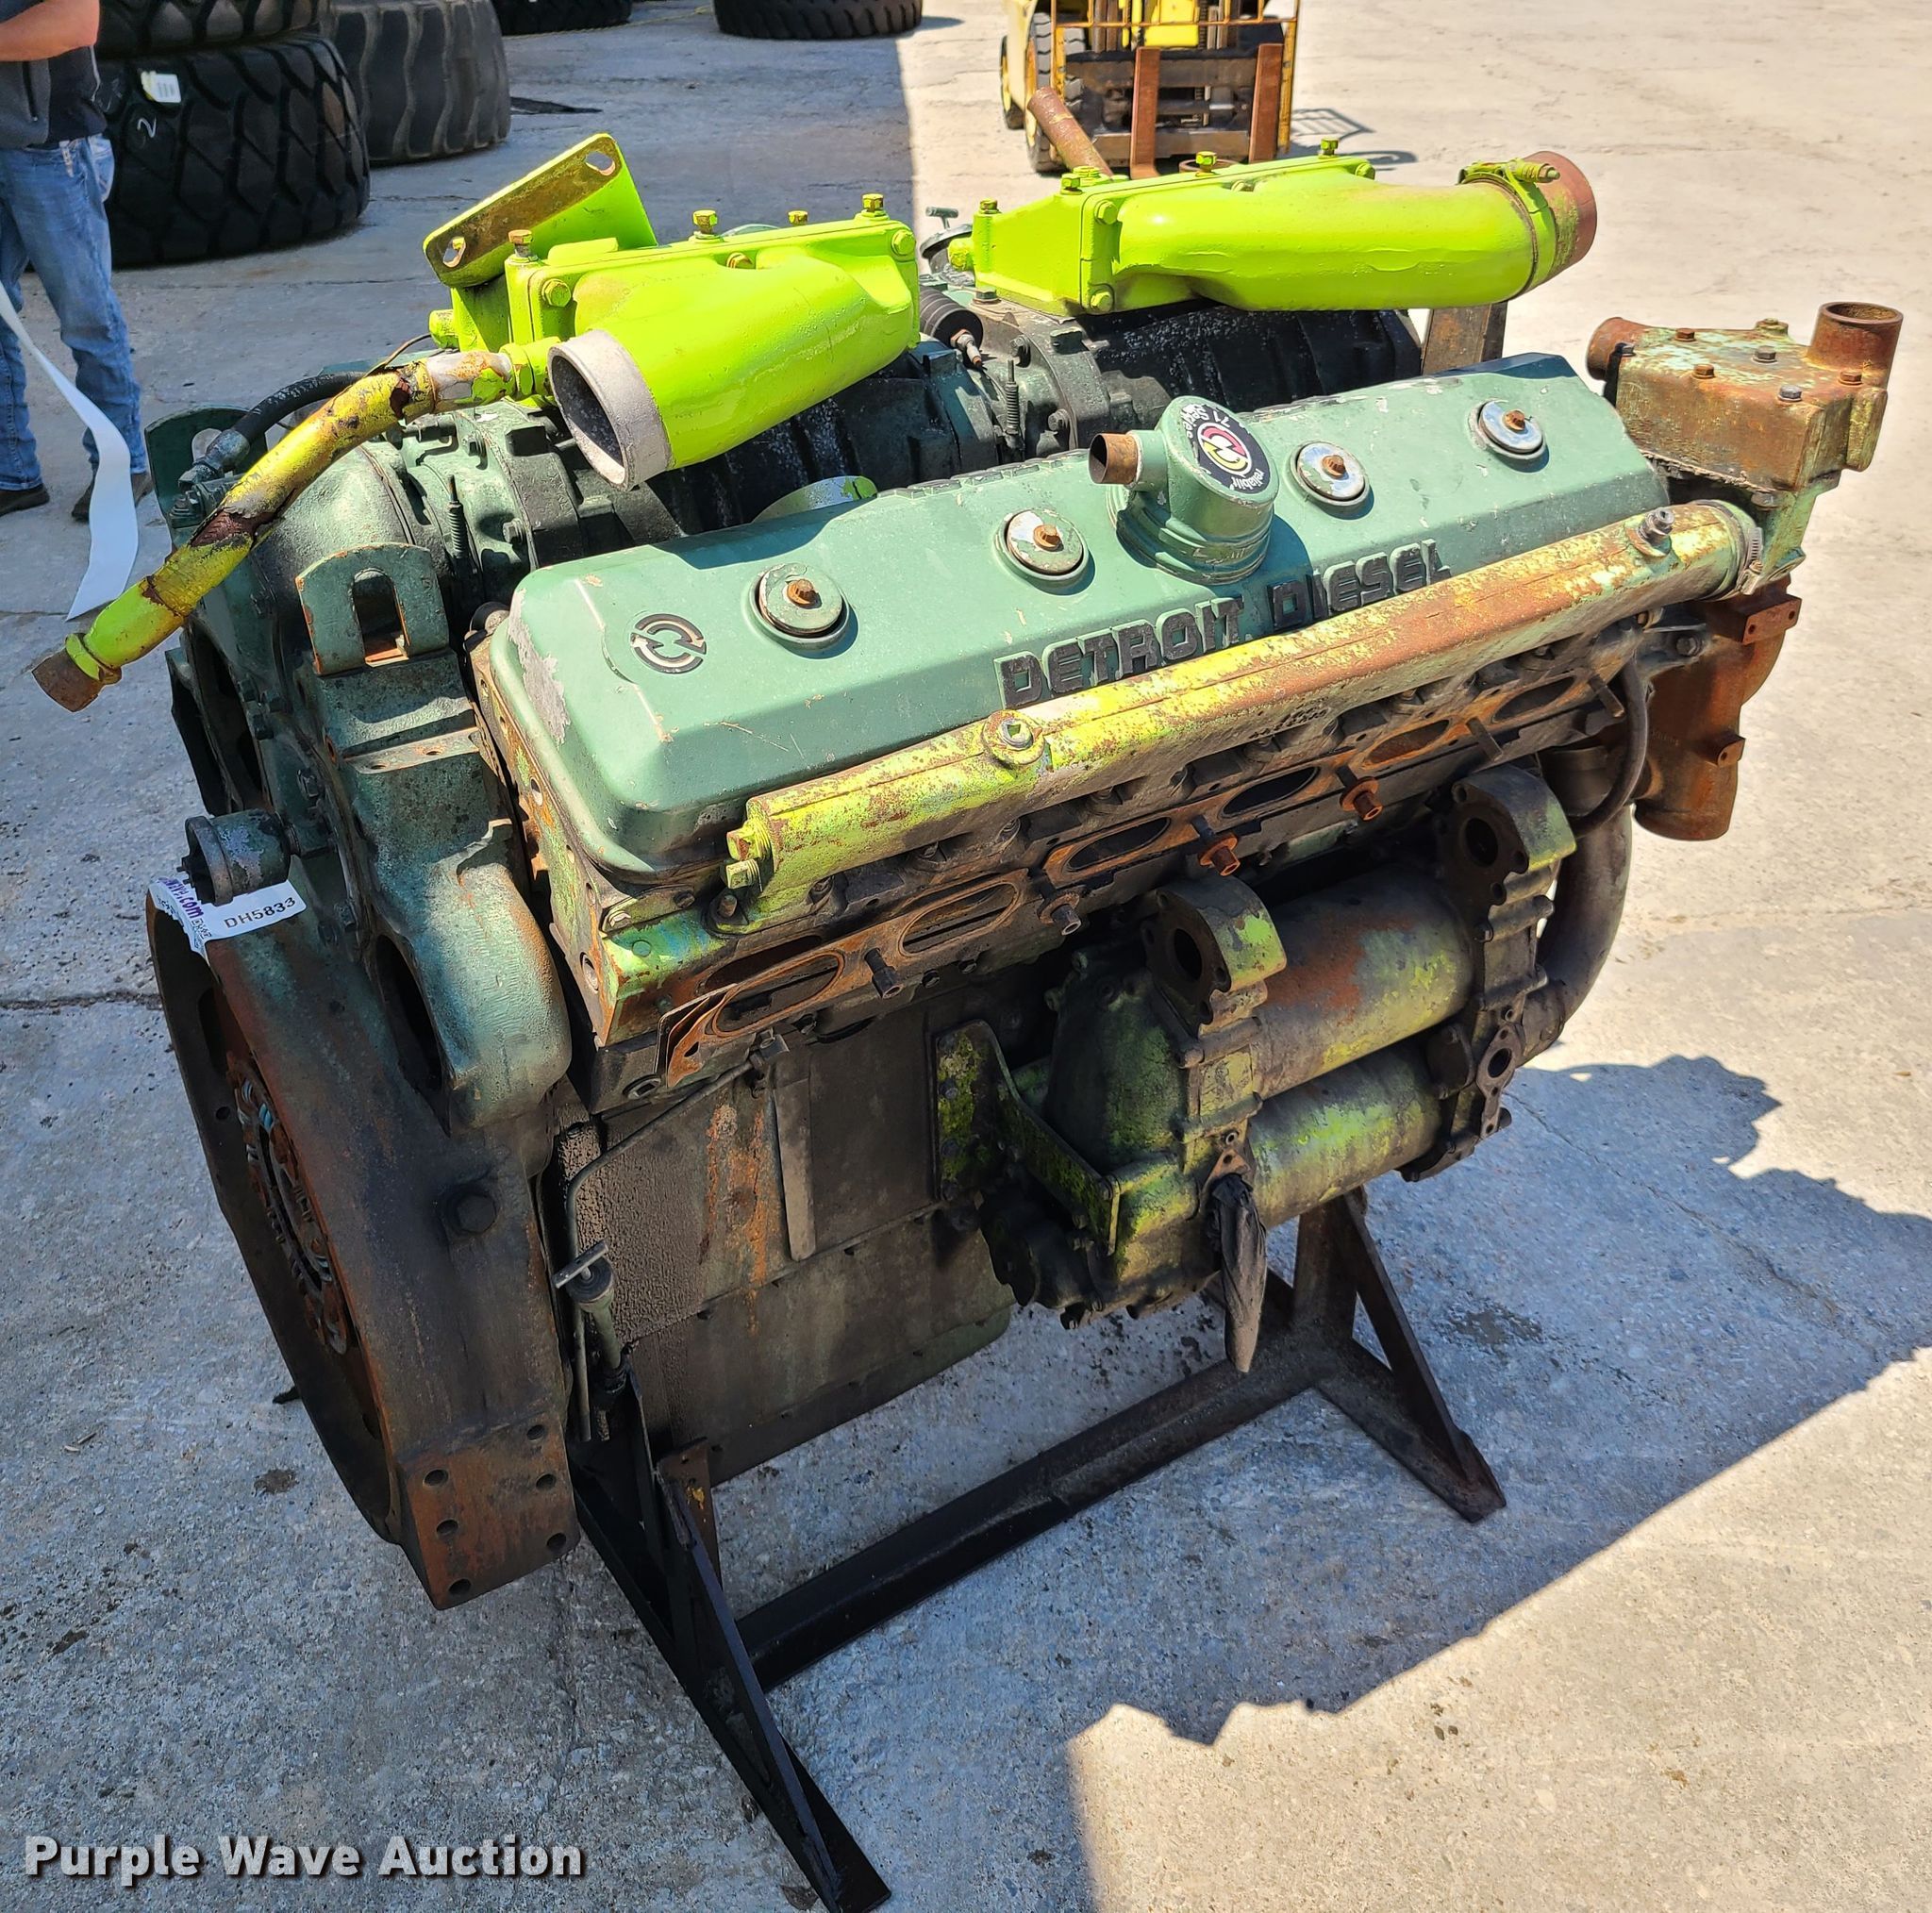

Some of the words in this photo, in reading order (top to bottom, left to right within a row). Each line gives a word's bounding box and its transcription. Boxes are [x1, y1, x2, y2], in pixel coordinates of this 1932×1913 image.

[994, 594, 1243, 709] DETROIT
[1267, 539, 1452, 631] DIESEL
[224, 897, 296, 929] DH5833
